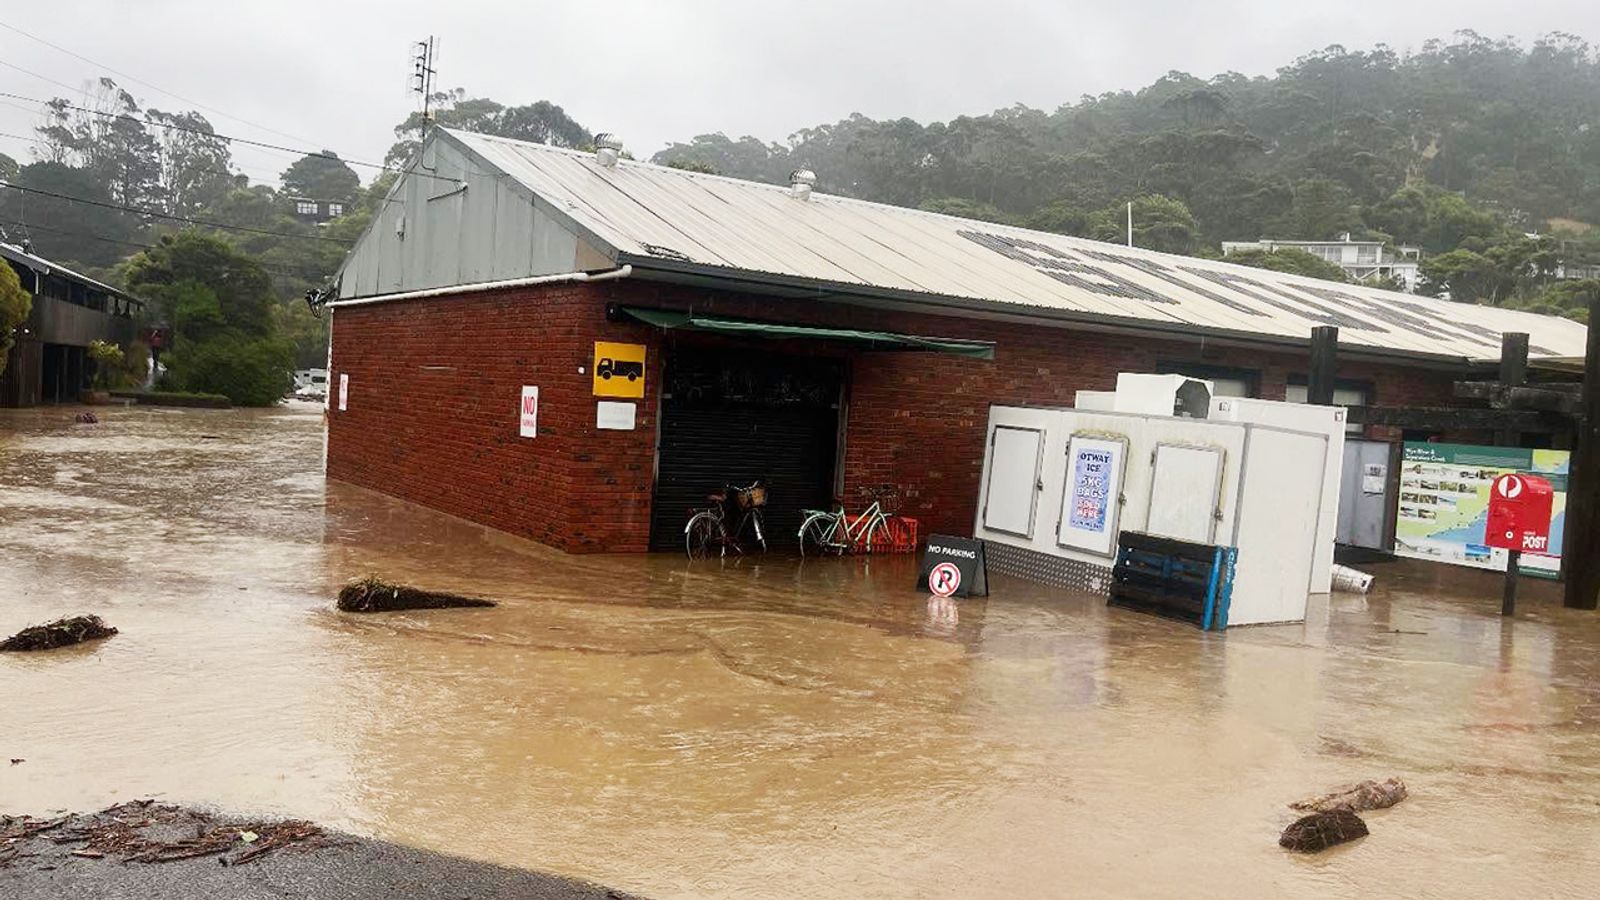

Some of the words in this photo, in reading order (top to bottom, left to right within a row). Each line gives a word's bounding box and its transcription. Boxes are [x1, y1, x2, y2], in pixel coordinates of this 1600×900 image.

[523, 396, 535, 415] NO
[1080, 452, 1110, 463] OTWAY
[1086, 463, 1101, 472] ICE
[1081, 474, 1103, 487] 5KG
[1076, 486, 1106, 499] BAGS
[1522, 535, 1547, 549] POST
[928, 544, 941, 554] NO
[942, 546, 976, 559] PARKING
